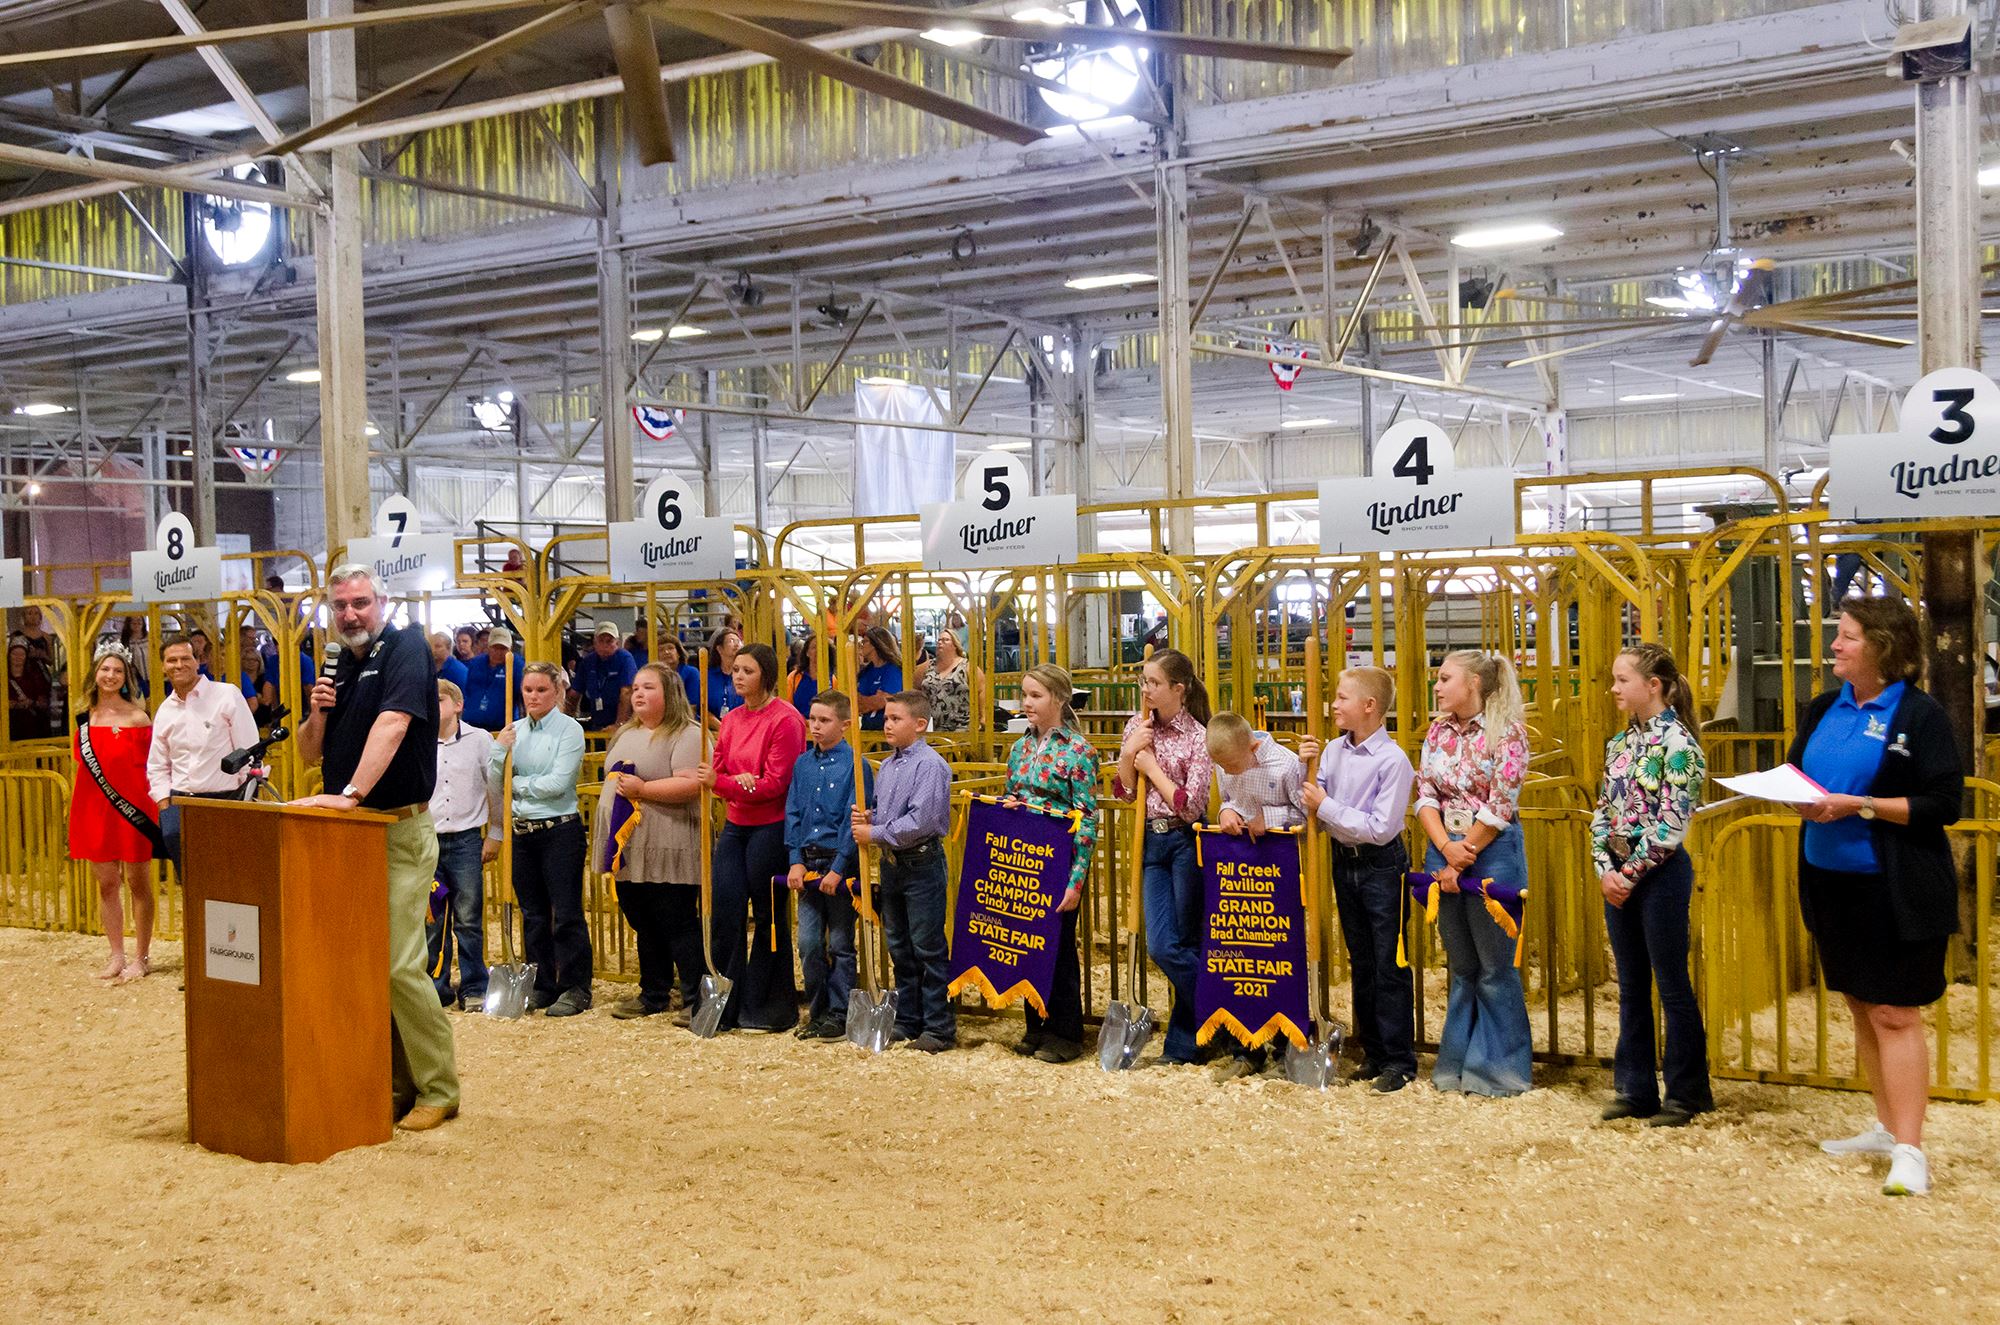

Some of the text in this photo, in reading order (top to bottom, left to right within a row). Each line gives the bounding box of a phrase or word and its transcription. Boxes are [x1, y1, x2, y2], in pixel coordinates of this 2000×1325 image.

[1928, 387, 1975, 445] 3
[1391, 436, 1434, 486] 4
[982, 466, 1011, 511] 5
[1890, 453, 2000, 499] Lindne
[657, 490, 682, 530] 6
[1367, 492, 1463, 535] Lindner
[167, 527, 183, 560] 8
[388, 512, 407, 548] 7
[959, 516, 1036, 554] Lindner
[640, 536, 702, 569] Lindner
[154, 564, 198, 593] Lindner
[98, 776, 118, 801] STATE
[115, 799, 136, 818] FAIR
[985, 832, 1055, 858] Fall Creek
[990, 848, 1044, 871] Pavilion
[1216, 862, 1281, 878] Fall Creek
[974, 879, 1053, 908] CHAMPION
[988, 868, 1040, 891] GRAND
[1219, 877, 1275, 893] Pavilion
[970, 911, 1002, 927] INDIANA
[976, 893, 1047, 921] Cindy Hoye
[1219, 899, 1275, 915] GRAND
[968, 919, 1046, 951] STATE FAIR
[1210, 914, 1291, 930] CHAMPION
[1210, 928, 1288, 943] Brad Chambers
[209, 947, 255, 961] FAIRGROUNDS
[988, 947, 1018, 967] 2021
[1207, 950, 1244, 959] INDIANA
[1207, 958, 1293, 976] STATE FAIR
[1233, 982, 1268, 997] 2021
